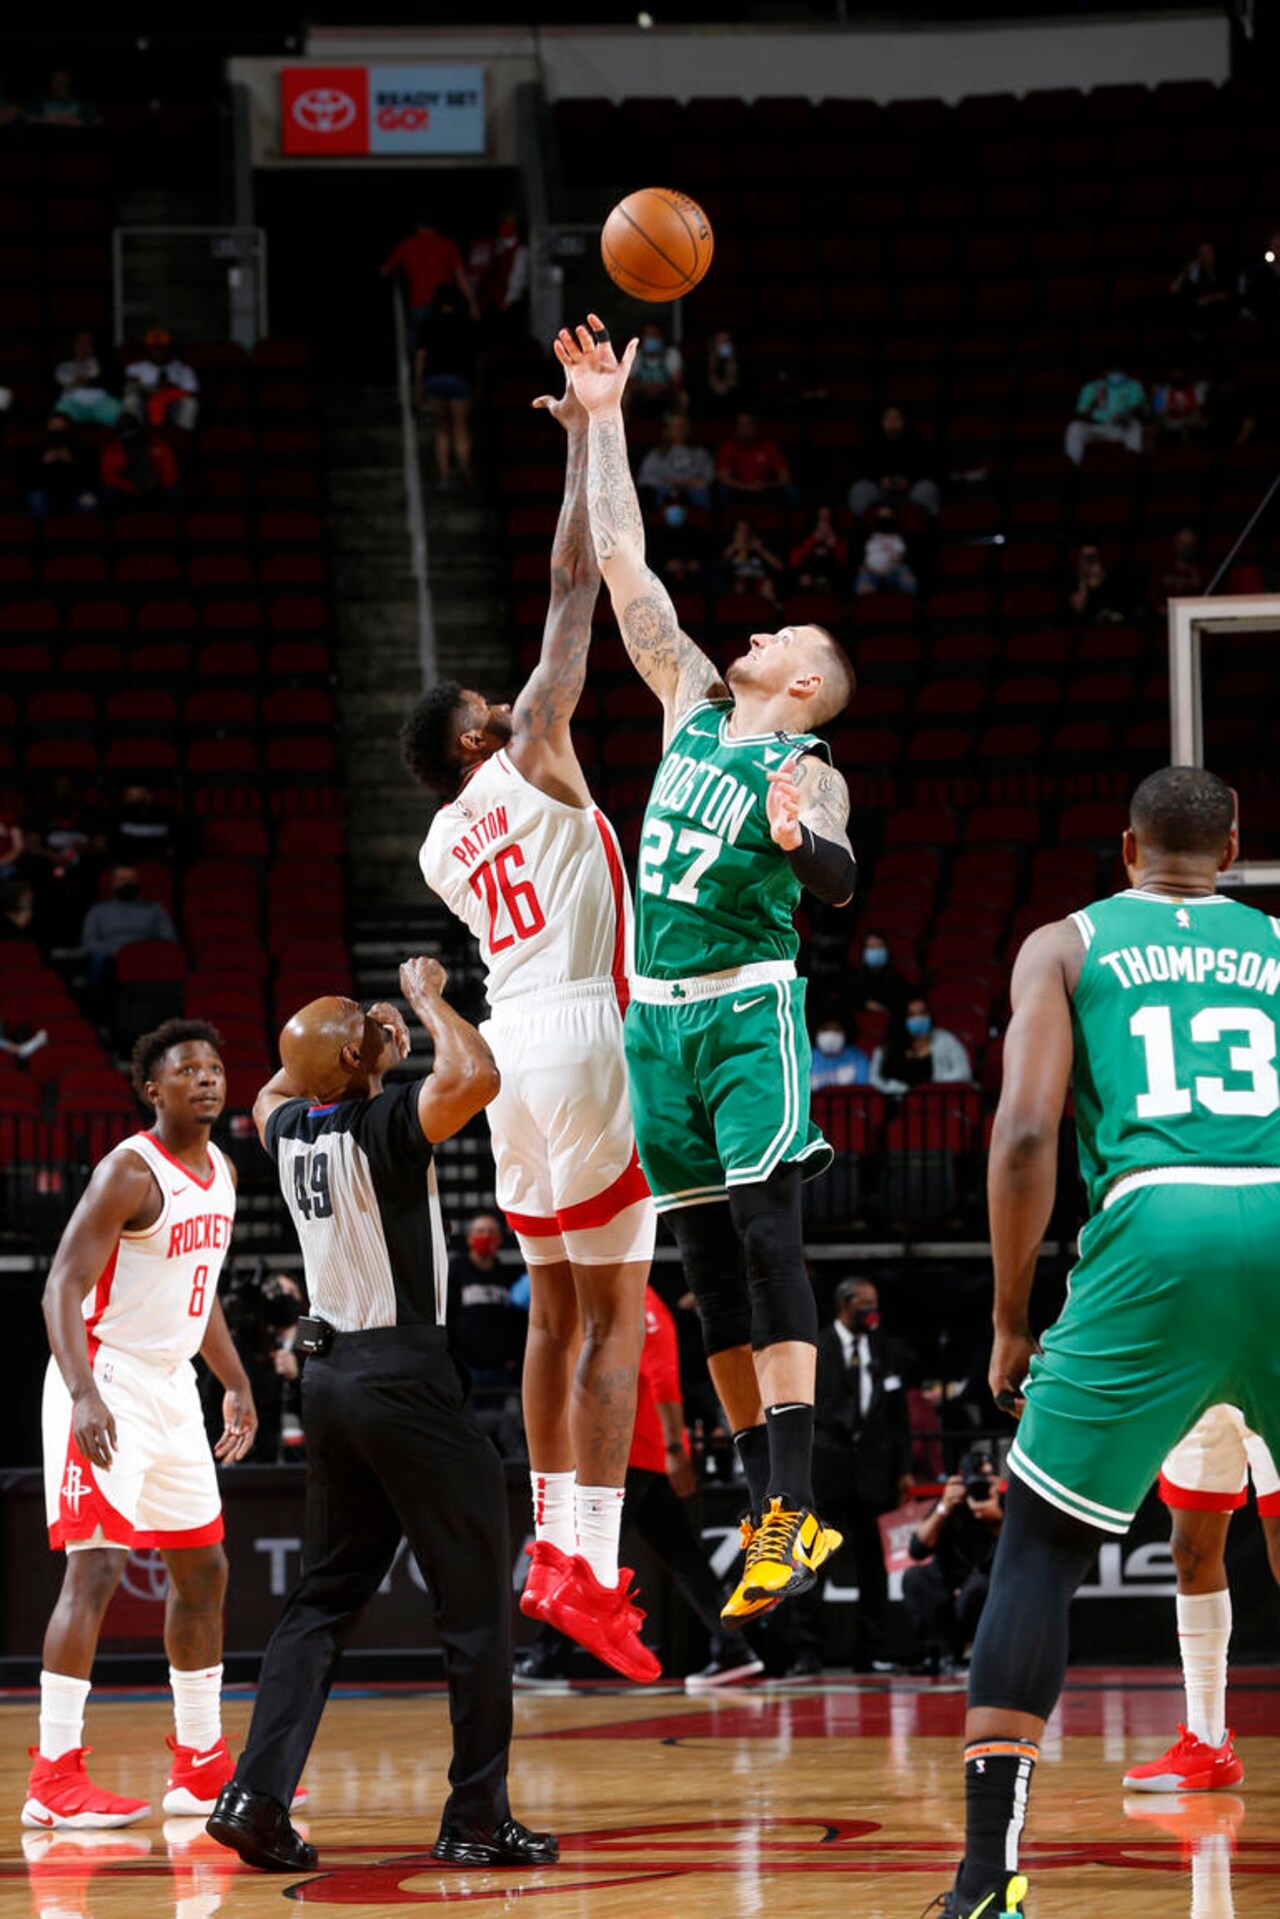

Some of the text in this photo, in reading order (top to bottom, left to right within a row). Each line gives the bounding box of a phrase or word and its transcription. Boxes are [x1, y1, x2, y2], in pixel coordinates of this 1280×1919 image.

[375, 107, 430, 132] GO!
[376, 91, 478, 107] READY SET
[650, 753, 757, 846] BOSTON
[452, 806, 509, 868] PATTON
[639, 818, 724, 905] 27
[469, 843, 556, 955] 26
[1099, 945, 1280, 996] THOMPSON
[1129, 1006, 1280, 1118] 13
[294, 1152, 333, 1221] 49
[167, 1213, 233, 1259] ROCKET
[188, 1265, 208, 1317] 8
